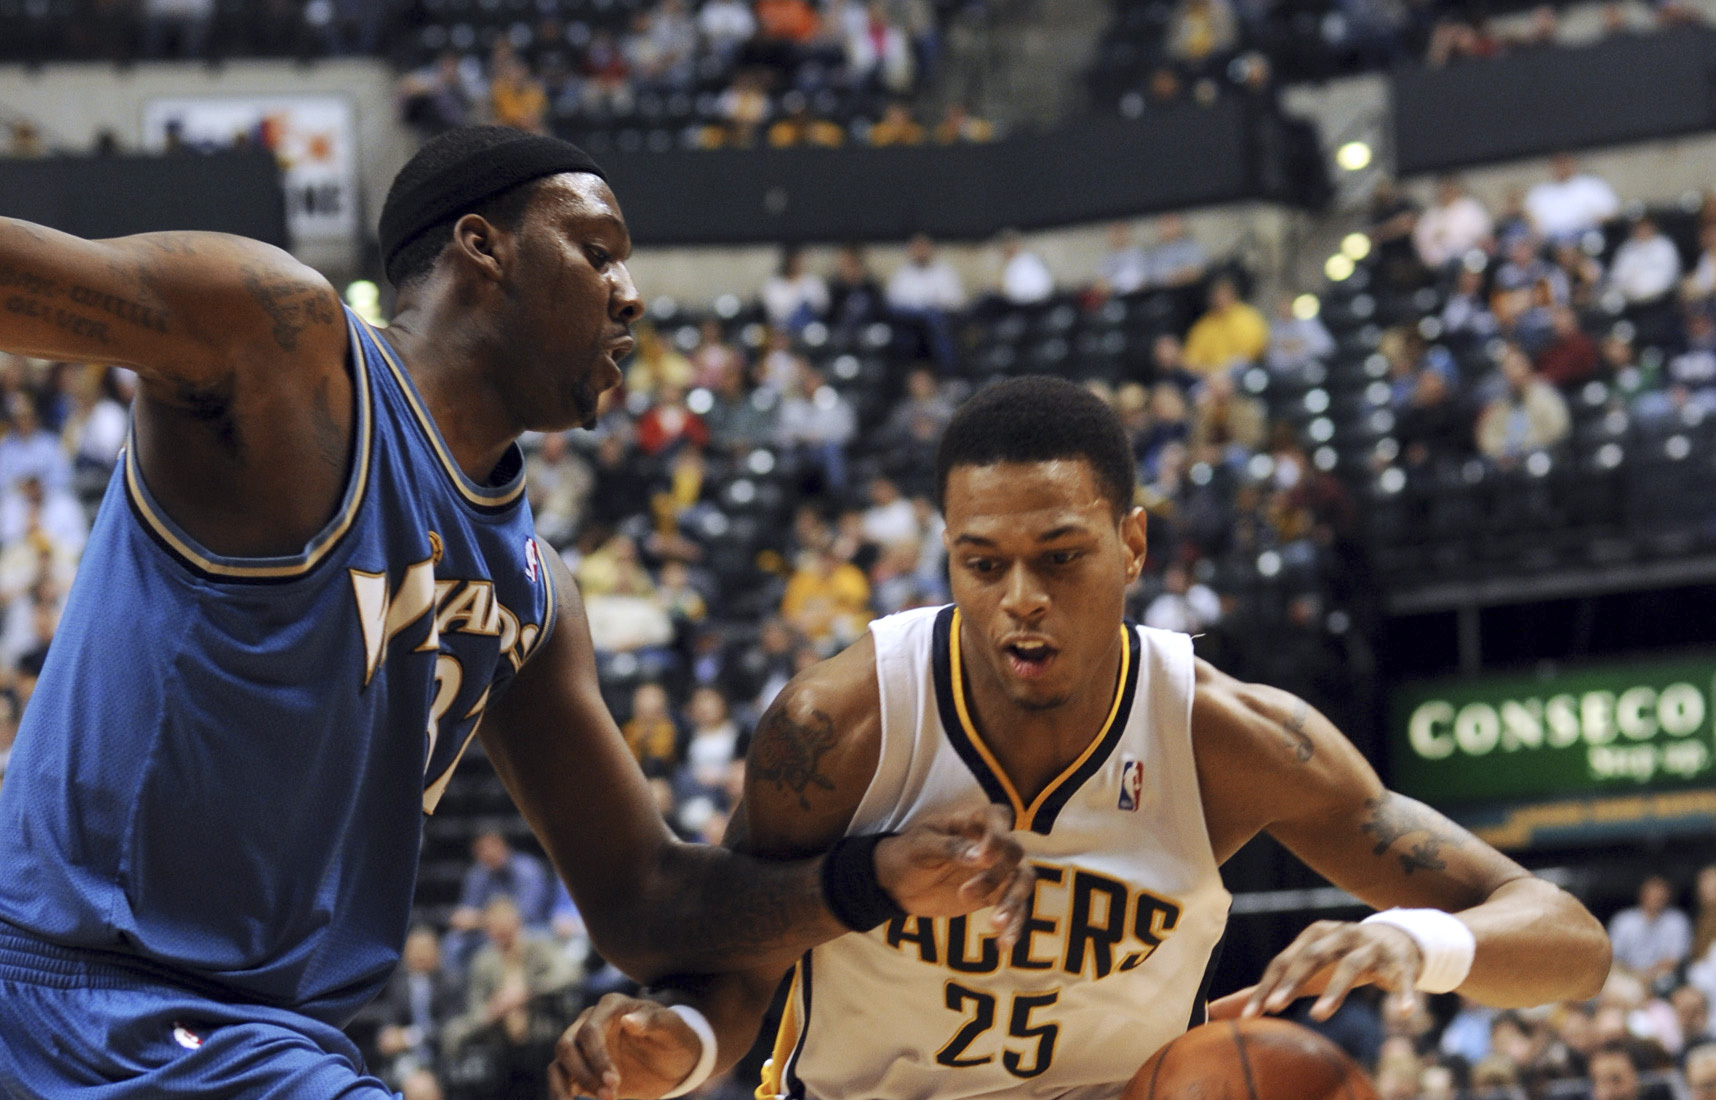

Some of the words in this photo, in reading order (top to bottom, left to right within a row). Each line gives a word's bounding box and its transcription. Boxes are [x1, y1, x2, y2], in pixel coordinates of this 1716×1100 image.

[1407, 682, 1706, 761] CONSECO
[884, 858, 1185, 982] ACERS
[934, 978, 1062, 1080] 25
